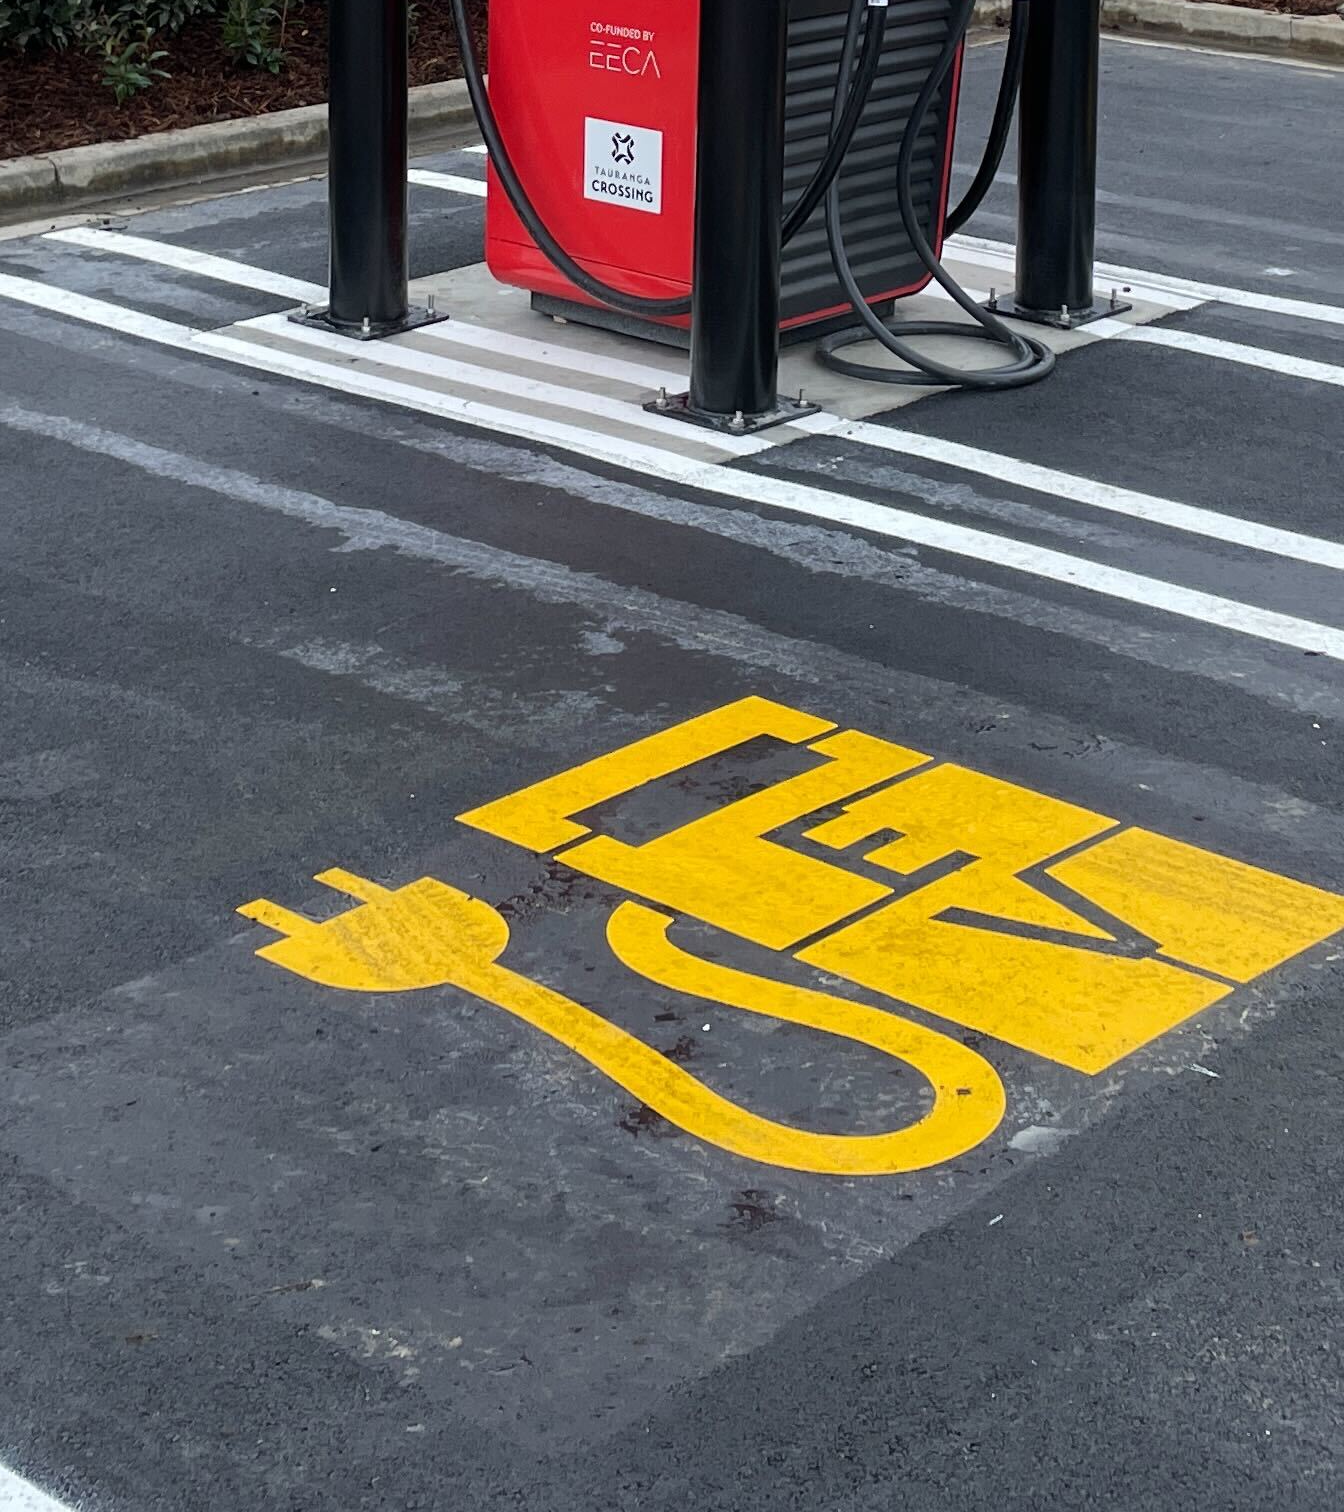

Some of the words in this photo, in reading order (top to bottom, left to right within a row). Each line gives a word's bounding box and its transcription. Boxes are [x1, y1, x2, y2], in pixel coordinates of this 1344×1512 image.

[590, 22, 640, 40] CO-FUNDED
[643, 31, 655, 41] BY
[589, 40, 661, 79] EECA
[594, 166, 651, 185] TAURANGA
[592, 180, 653, 203] CROSSING
